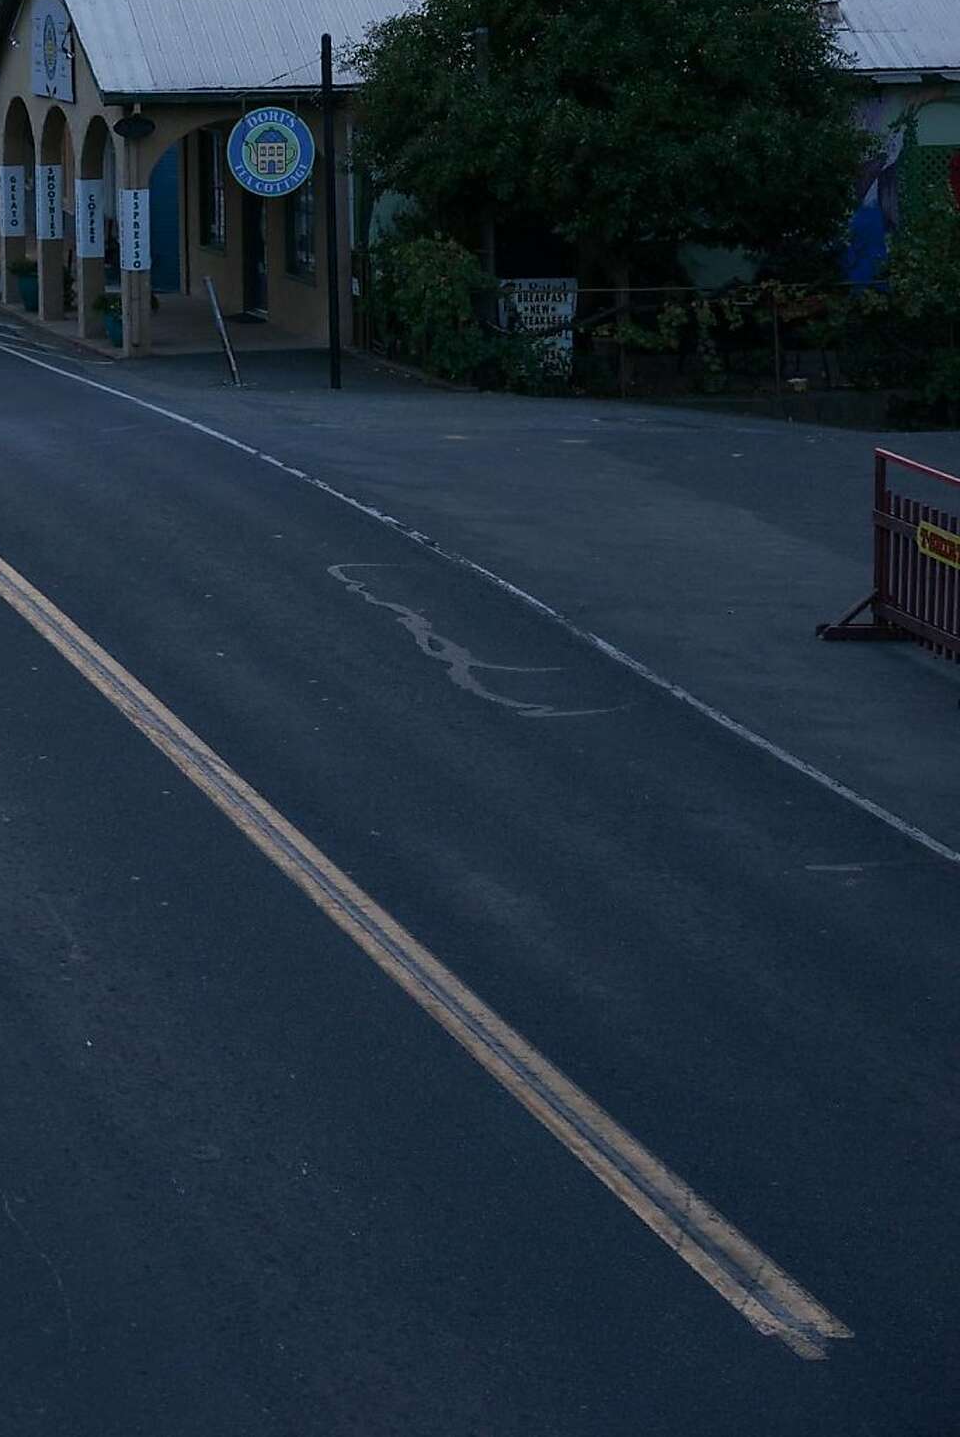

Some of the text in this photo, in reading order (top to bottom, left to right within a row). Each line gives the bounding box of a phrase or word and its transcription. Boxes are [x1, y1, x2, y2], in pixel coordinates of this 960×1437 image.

[9, 175, 18, 227] GELATO
[48, 167, 57, 238] SMOOTHIES
[87, 194, 96, 244] COFFEE
[133, 191, 141, 269] ESPRESSO
